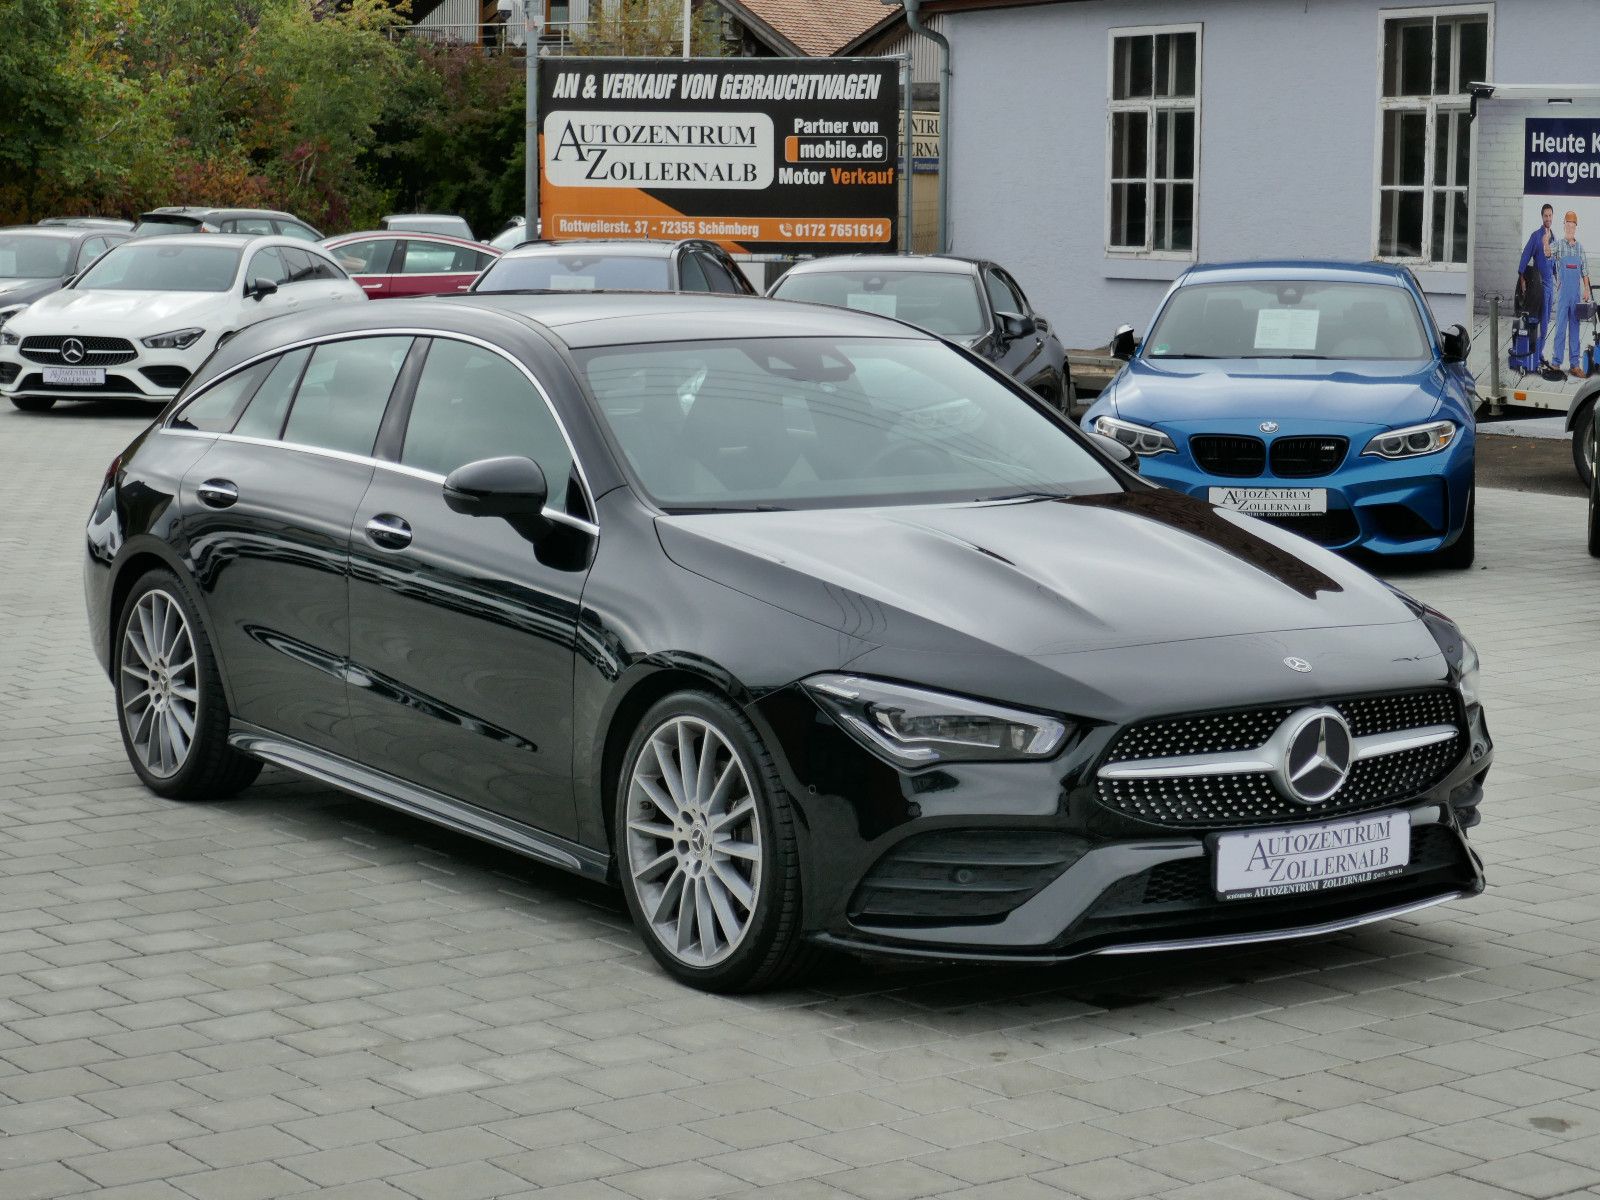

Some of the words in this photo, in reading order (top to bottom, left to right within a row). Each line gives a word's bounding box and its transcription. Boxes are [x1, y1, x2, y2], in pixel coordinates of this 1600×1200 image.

[552, 73, 580, 98] AN
[582, 74, 597, 99] &
[602, 73, 677, 99] VERKAUF
[681, 74, 718, 99] VON
[720, 74, 881, 100] GEBRAUCHTWAGEN
[794, 118, 848, 134] Partner
[853, 121, 878, 134] von
[552, 120, 756, 161] AUTOZENTRUM
[800, 140, 883, 159] mobile.de
[1531, 132, 1586, 153] Heute
[585, 148, 757, 182] ZOLLERNALB
[778, 167, 826, 185] Motor
[830, 168, 894, 185] Verkauf
[1531, 161, 1600, 184] morgen
[559, 219, 631, 234] Rottweilerstr.
[635, 220, 648, 234] 37
[661, 221, 695, 235] 72355
[698, 220, 759, 238] Schömberg
[795, 223, 826, 237] 0172
[829, 223, 883, 237] 7651614
[1221, 490, 1311, 504] AUTOZENTRUM
[1238, 500, 1311, 511] ZOLLERNALB
[1244, 820, 1391, 872] AUTOZENTRUM
[1269, 846, 1389, 882] ZOLLERNALB
[1254, 881, 1319, 898] AUTOZENTRUM
[1322, 872, 1372, 889] ZOLLERNALB
